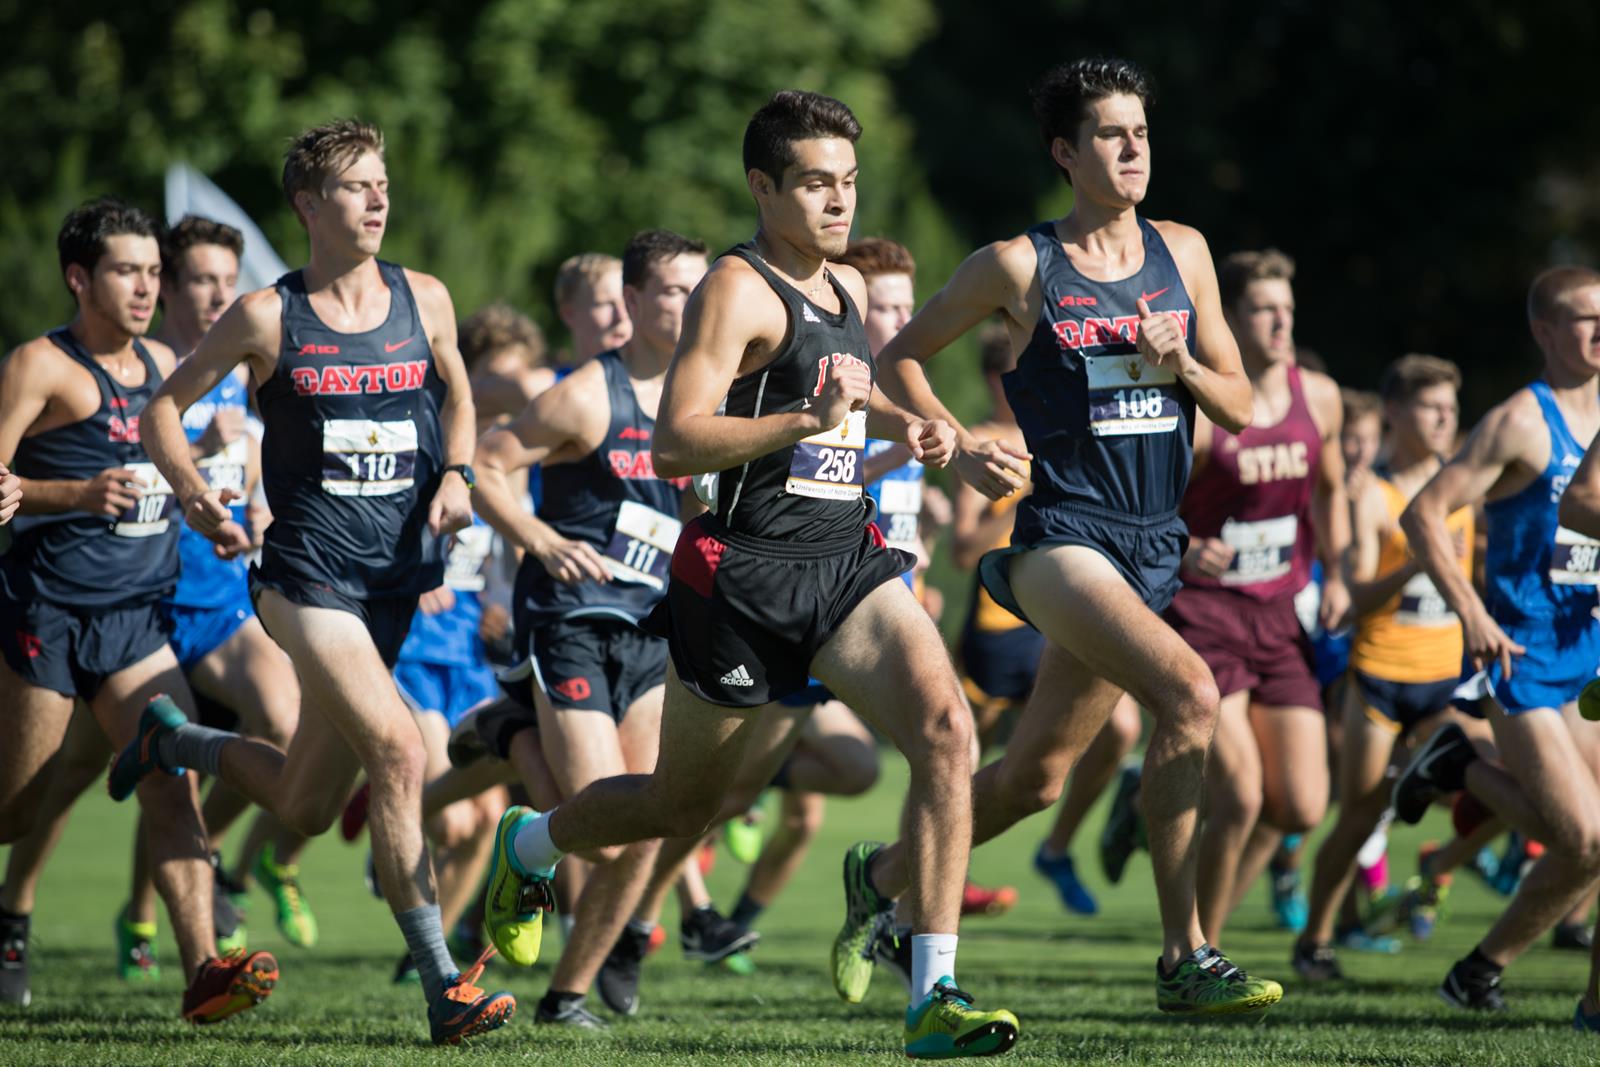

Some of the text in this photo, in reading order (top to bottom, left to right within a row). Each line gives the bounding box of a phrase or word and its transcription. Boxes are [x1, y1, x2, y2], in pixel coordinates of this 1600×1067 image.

[1052, 310, 1190, 349] DAYTN
[291, 359, 428, 396] DAYTON
[1114, 388, 1163, 418] 108
[347, 453, 397, 481] 110
[814, 447, 857, 483] 258
[1237, 441, 1309, 484] STAC
[137, 494, 168, 523] 107
[623, 539, 660, 575] 111
[720, 675, 754, 687] adidas
